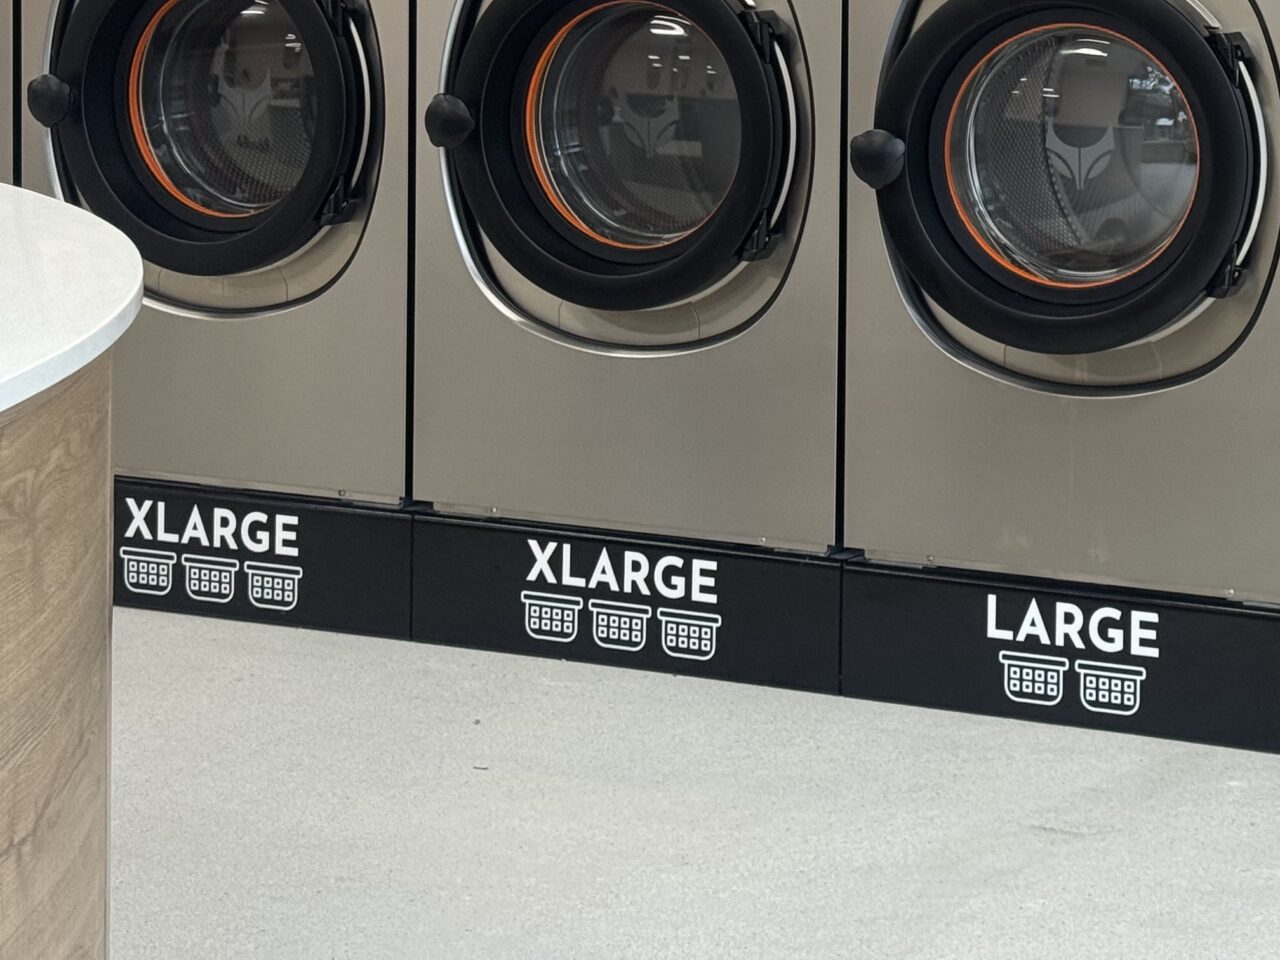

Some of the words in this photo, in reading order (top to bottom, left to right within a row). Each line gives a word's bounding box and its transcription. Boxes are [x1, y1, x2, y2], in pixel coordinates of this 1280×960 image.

[124, 497, 300, 557] XLARGE
[525, 538, 719, 604] XLARGE
[986, 593, 1160, 658] LARGE
